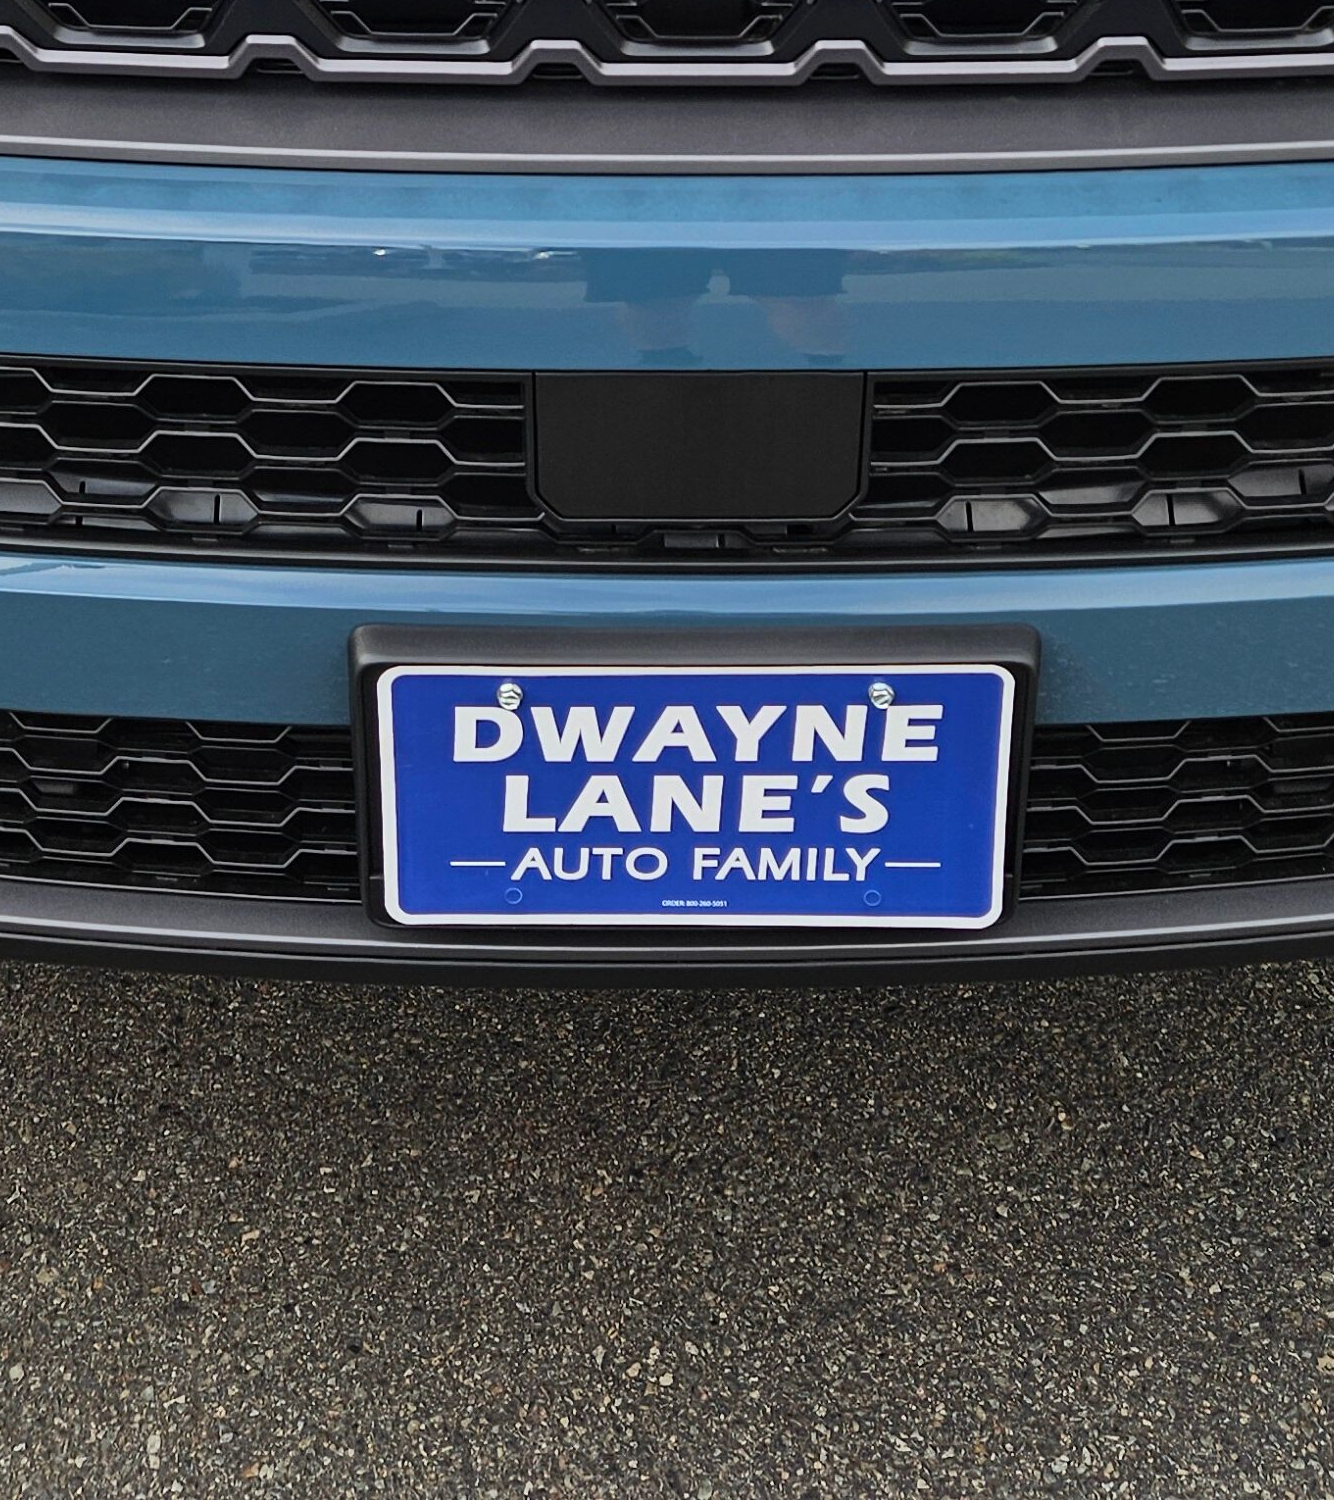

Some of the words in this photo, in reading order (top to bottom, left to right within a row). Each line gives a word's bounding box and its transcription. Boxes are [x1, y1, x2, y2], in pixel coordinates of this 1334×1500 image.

[452, 704, 944, 763] DWAYNE
[502, 774, 890, 833] LANE'S
[510, 847, 668, 881] AUTO
[692, 847, 881, 882] FAMILY
